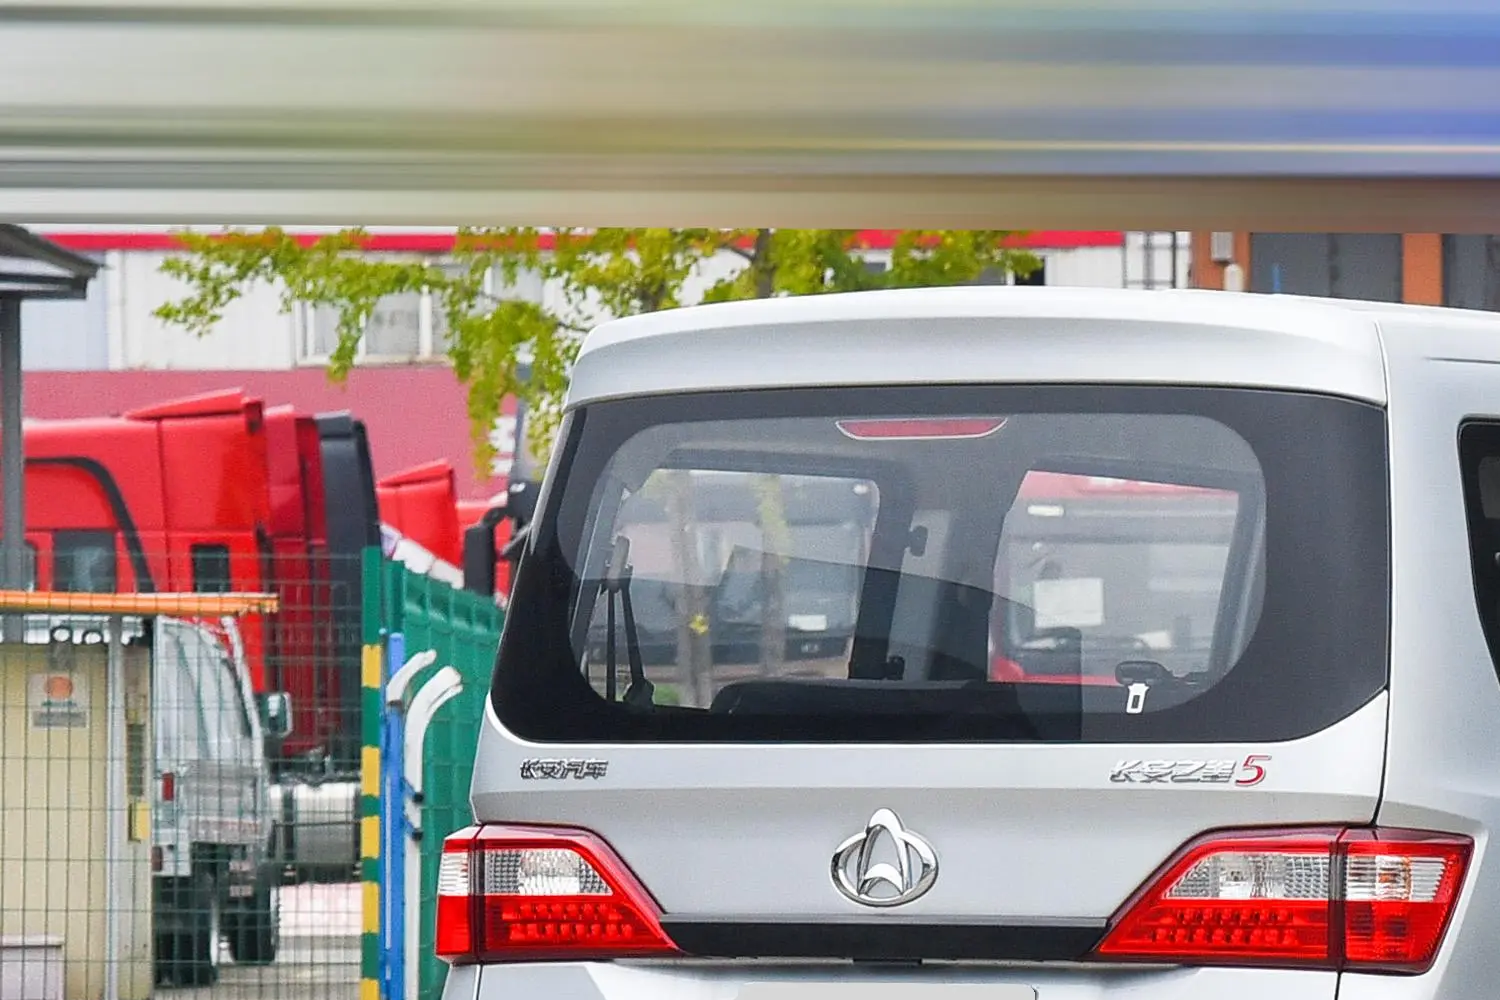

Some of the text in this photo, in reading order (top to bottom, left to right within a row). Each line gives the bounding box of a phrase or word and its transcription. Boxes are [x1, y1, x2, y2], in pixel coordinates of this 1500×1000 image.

[520, 759, 609, 780] 长安汽车
[1110, 754, 1273, 786] 长安之星5
